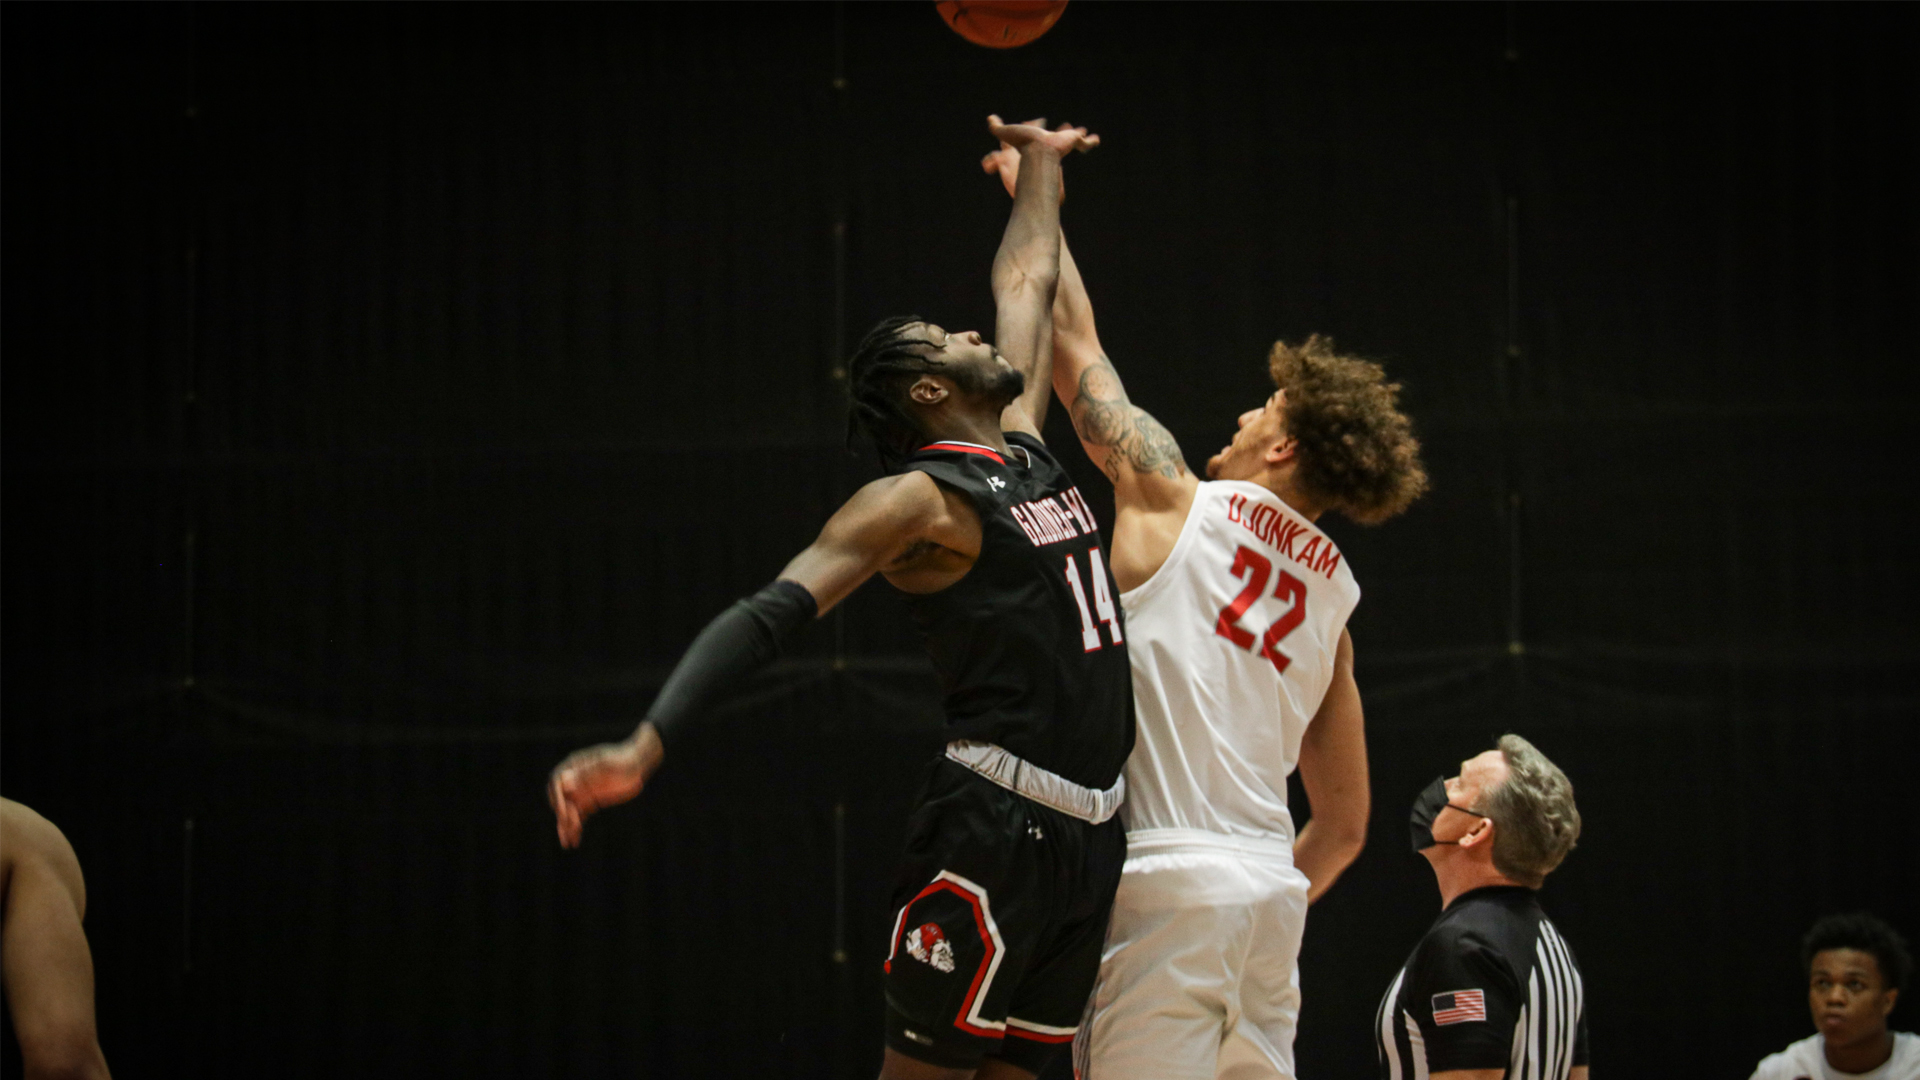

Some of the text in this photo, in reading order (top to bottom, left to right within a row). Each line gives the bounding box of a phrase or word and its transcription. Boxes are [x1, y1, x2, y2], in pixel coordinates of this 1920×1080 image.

[1228, 492, 1341, 580] DJONKAM
[1064, 546, 1123, 653] 14
[1214, 545, 1307, 675] 22
